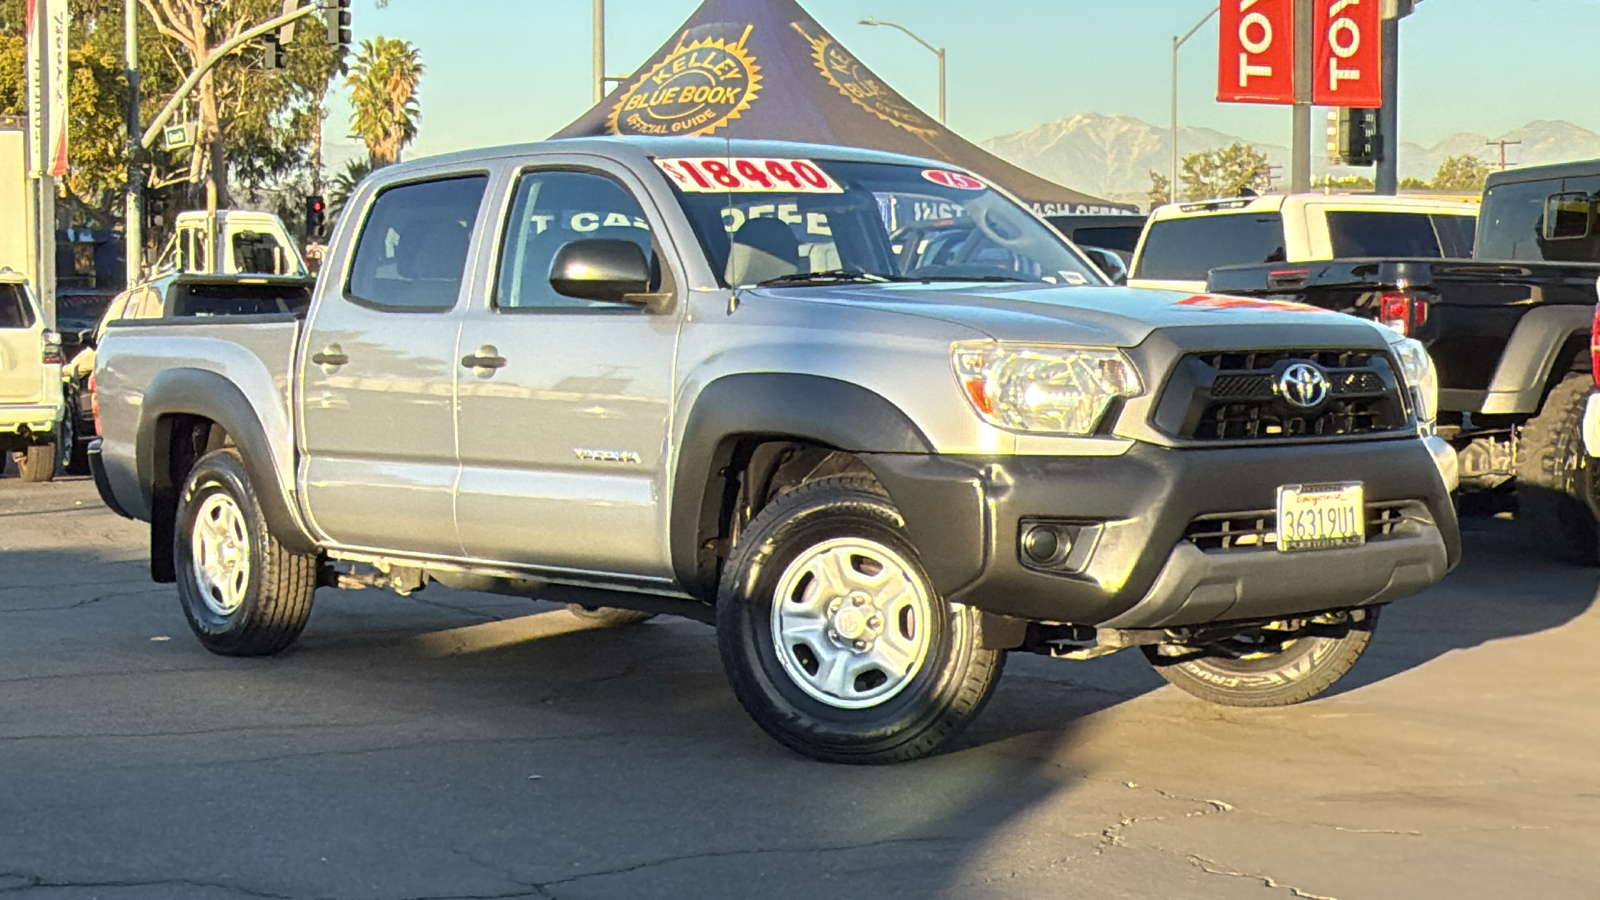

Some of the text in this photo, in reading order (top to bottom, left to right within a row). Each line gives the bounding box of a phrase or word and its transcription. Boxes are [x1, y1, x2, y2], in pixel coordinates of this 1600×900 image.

[652, 51, 743, 86] KELLEY
[624, 85, 742, 112] BLUE BOOK
[671, 108, 717, 132] GUIDE
